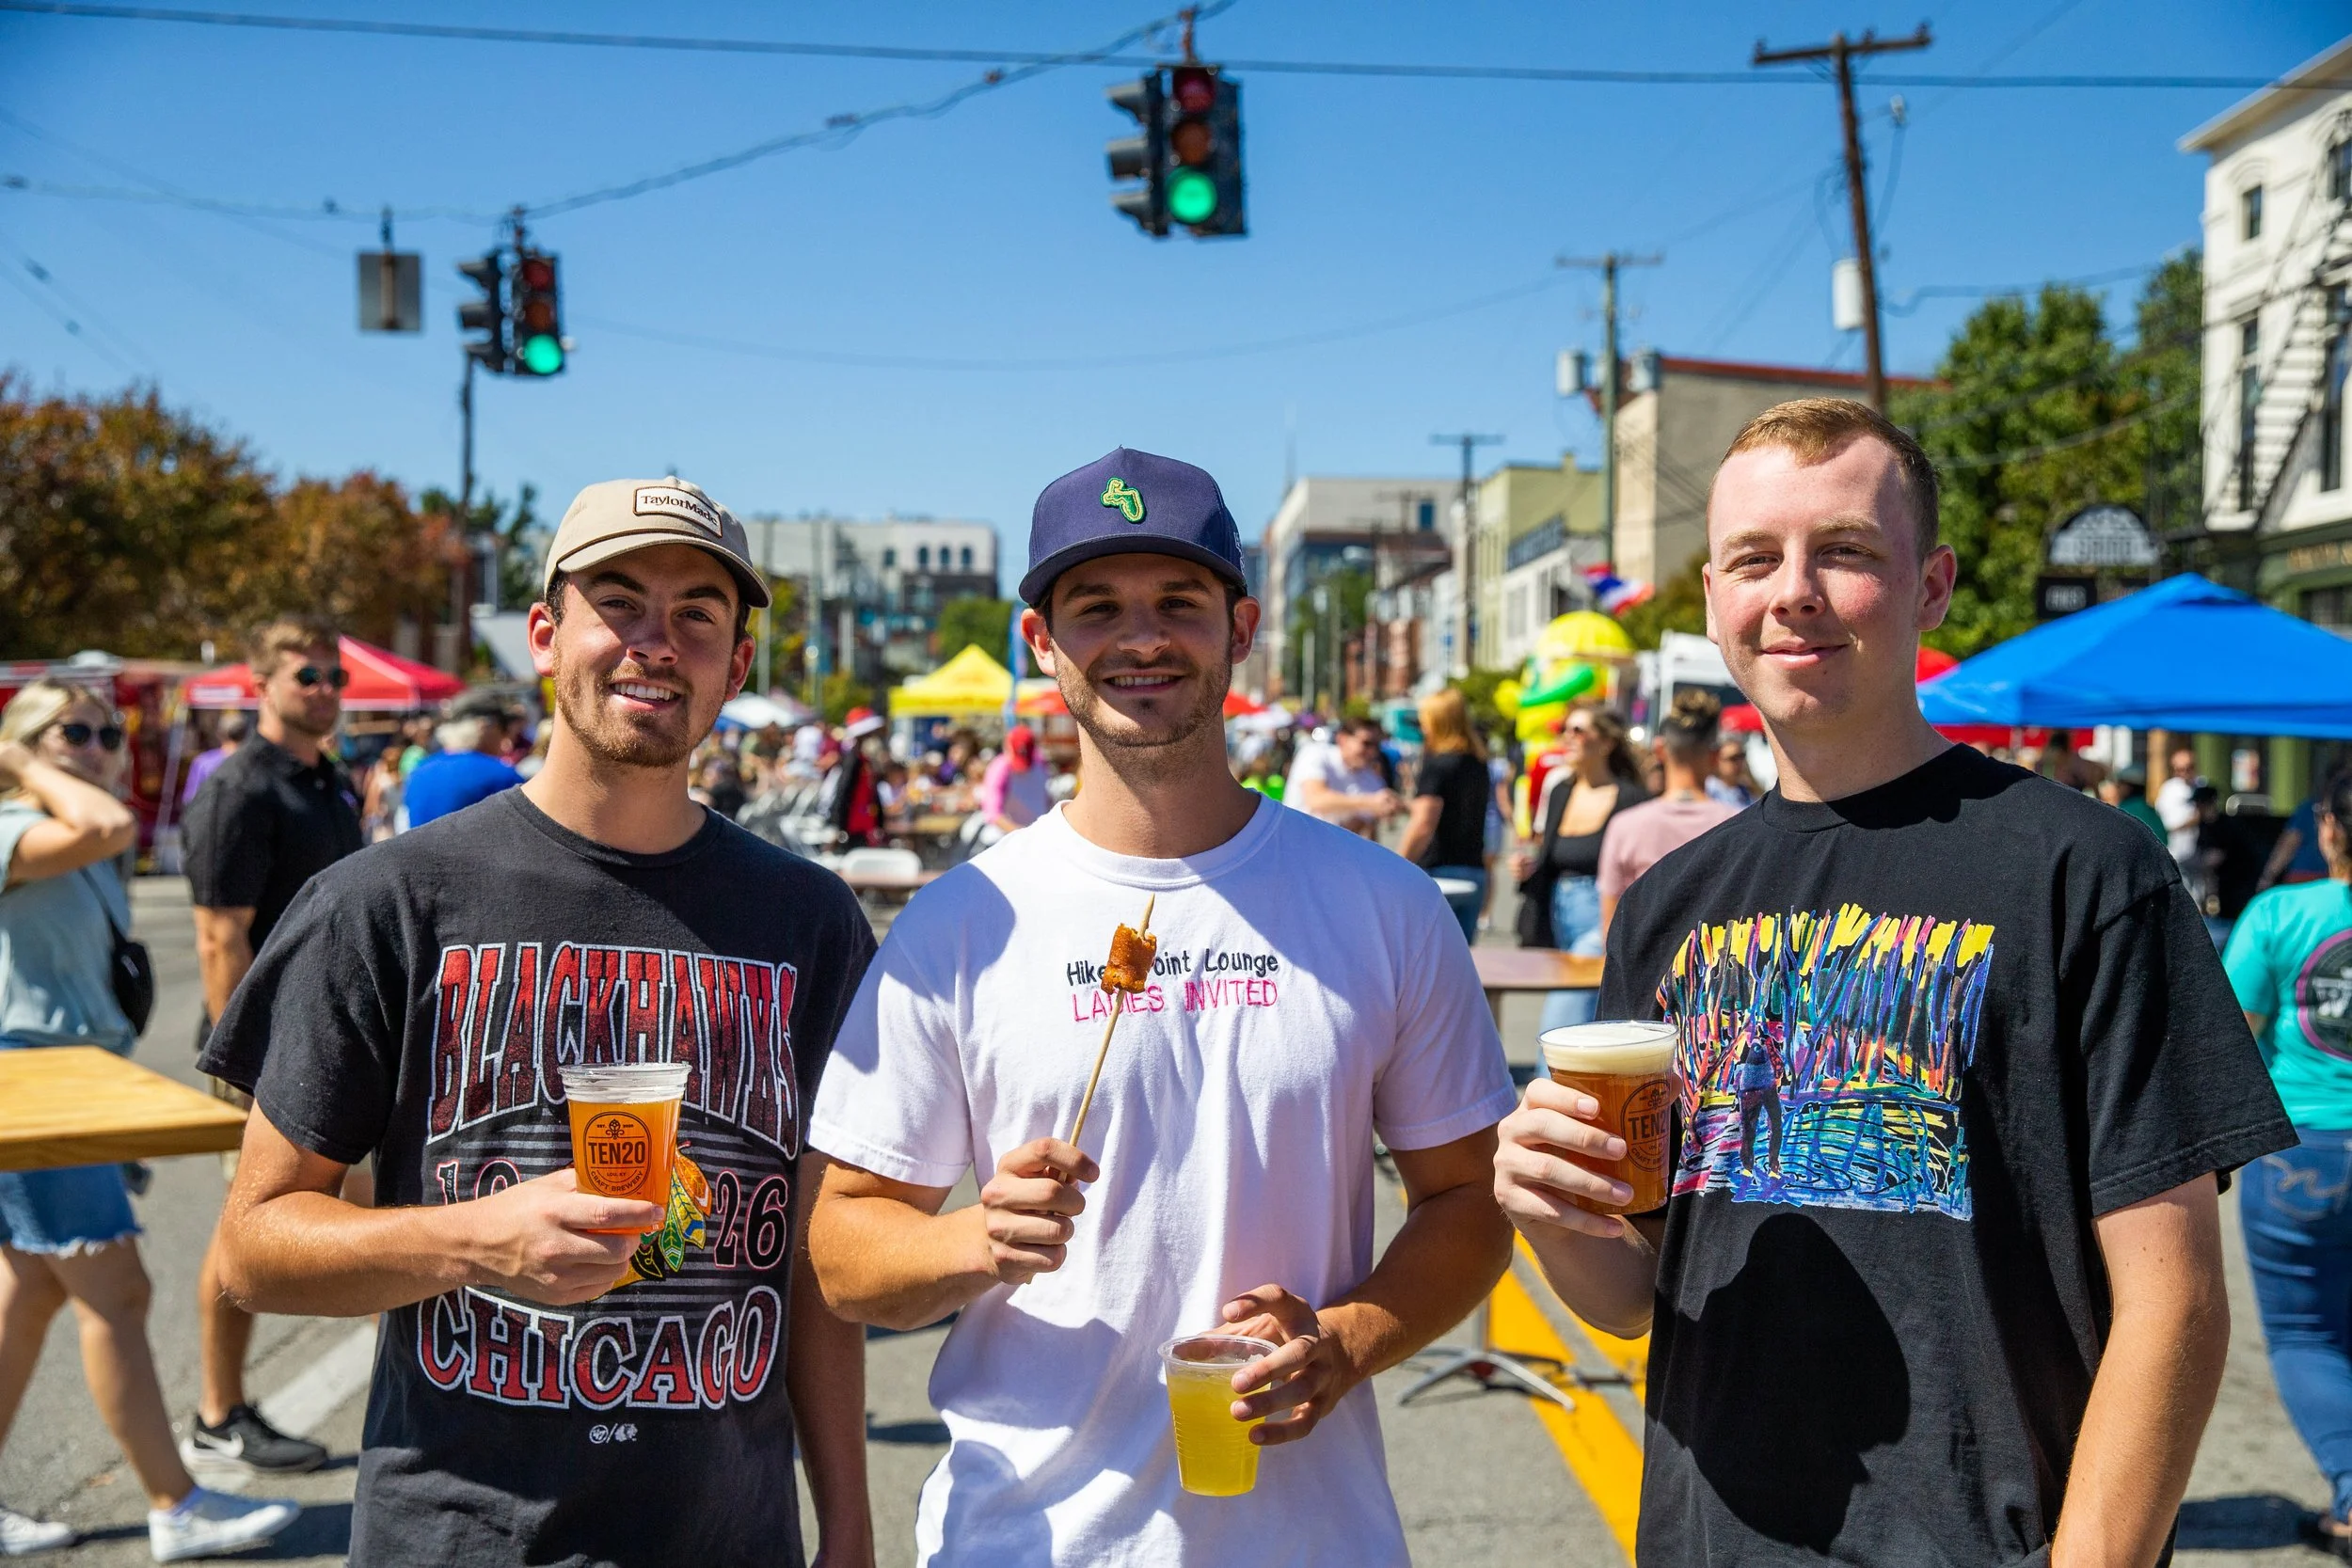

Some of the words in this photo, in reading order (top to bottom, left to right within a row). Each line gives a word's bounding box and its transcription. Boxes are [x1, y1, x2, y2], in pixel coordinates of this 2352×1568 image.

[641, 494, 719, 527] TaylorMade
[1066, 959, 1106, 986] Hike
[1152, 949, 1191, 976] oint
[1204, 948, 1279, 978] Lounge
[1184, 978, 1279, 1013] INVITED
[427, 941, 799, 1161] BLACKHAWKS
[588, 1141, 646, 1165] TEN20
[591, 1171, 610, 1191] CRAFT
[612, 1170, 644, 1192] BREWERY
[713, 1170, 788, 1271] 26
[417, 1285, 782, 1411] CHICAGO
